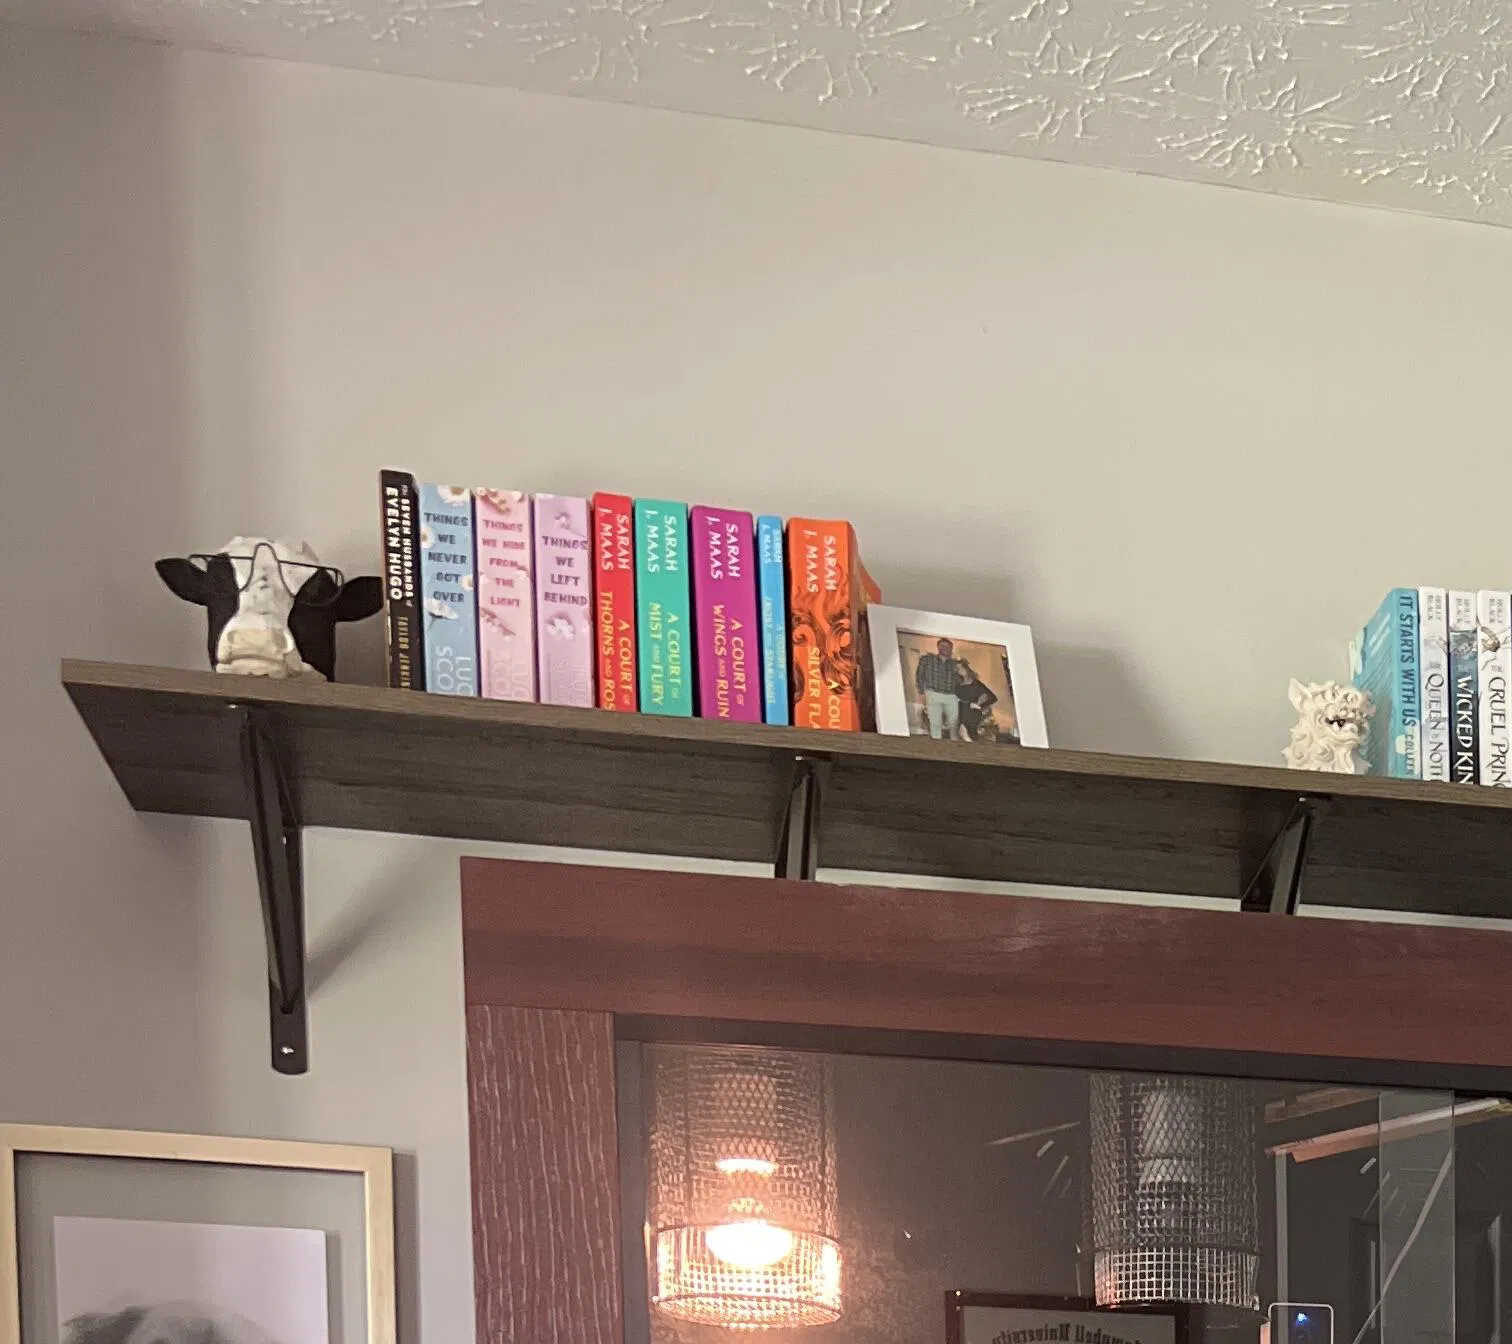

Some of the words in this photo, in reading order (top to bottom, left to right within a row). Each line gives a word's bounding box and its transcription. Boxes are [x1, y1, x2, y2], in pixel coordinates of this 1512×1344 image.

[386, 486, 401, 547] EVELYN
[401, 498, 411, 535] SEVEN
[424, 512, 468, 526] THINGS
[482, 518, 523, 532] THINGS
[438, 534, 456, 544] WE
[482, 538, 498, 548] WE
[502, 541, 525, 550] HIDE
[542, 535, 588, 550] THINGS
[600, 522, 614, 570] MAAS
[616, 514, 630, 570] SARAH
[647, 524, 660, 574] MAAS
[664, 516, 678, 572] SARAH
[708, 531, 724, 580] MAAS
[726, 522, 741, 578] SARAH
[388, 552, 403, 600] HUGO
[402, 538, 414, 597] HUSBANDS
[428, 552, 467, 565] NEVER
[489, 557, 518, 568] FROM
[556, 556, 574, 568] WE
[806, 546, 819, 594] MAAS
[824, 536, 837, 591] SARAH
[433, 590, 464, 602] OVER
[436, 572, 461, 585] GOT
[496, 577, 514, 588] THE
[550, 574, 581, 586] LEFT
[490, 596, 520, 608] LIGHT
[544, 592, 588, 606] BEHIND
[667, 612, 680, 624] A
[1400, 596, 1413, 609] IT
[600, 591, 614, 656] THORNS
[618, 618, 630, 632] A
[648, 602, 662, 640] MIST
[712, 604, 728, 656] WINGS
[731, 618, 744, 631] A
[1400, 613, 1414, 664] STARTS
[619, 637, 632, 692] COURT
[668, 629, 682, 686] COURT
[732, 636, 746, 692] COURT
[808, 648, 821, 698] SILVER
[651, 664, 664, 706] FURY
[716, 679, 730, 718] RUIN
[828, 680, 840, 691] A
[1401, 668, 1416, 704] WITH
[1424, 673, 1444, 730] QUEEN
[1402, 708, 1416, 728] US
[1456, 675, 1474, 748] WICKED
[1488, 676, 1506, 736] CRUEL
